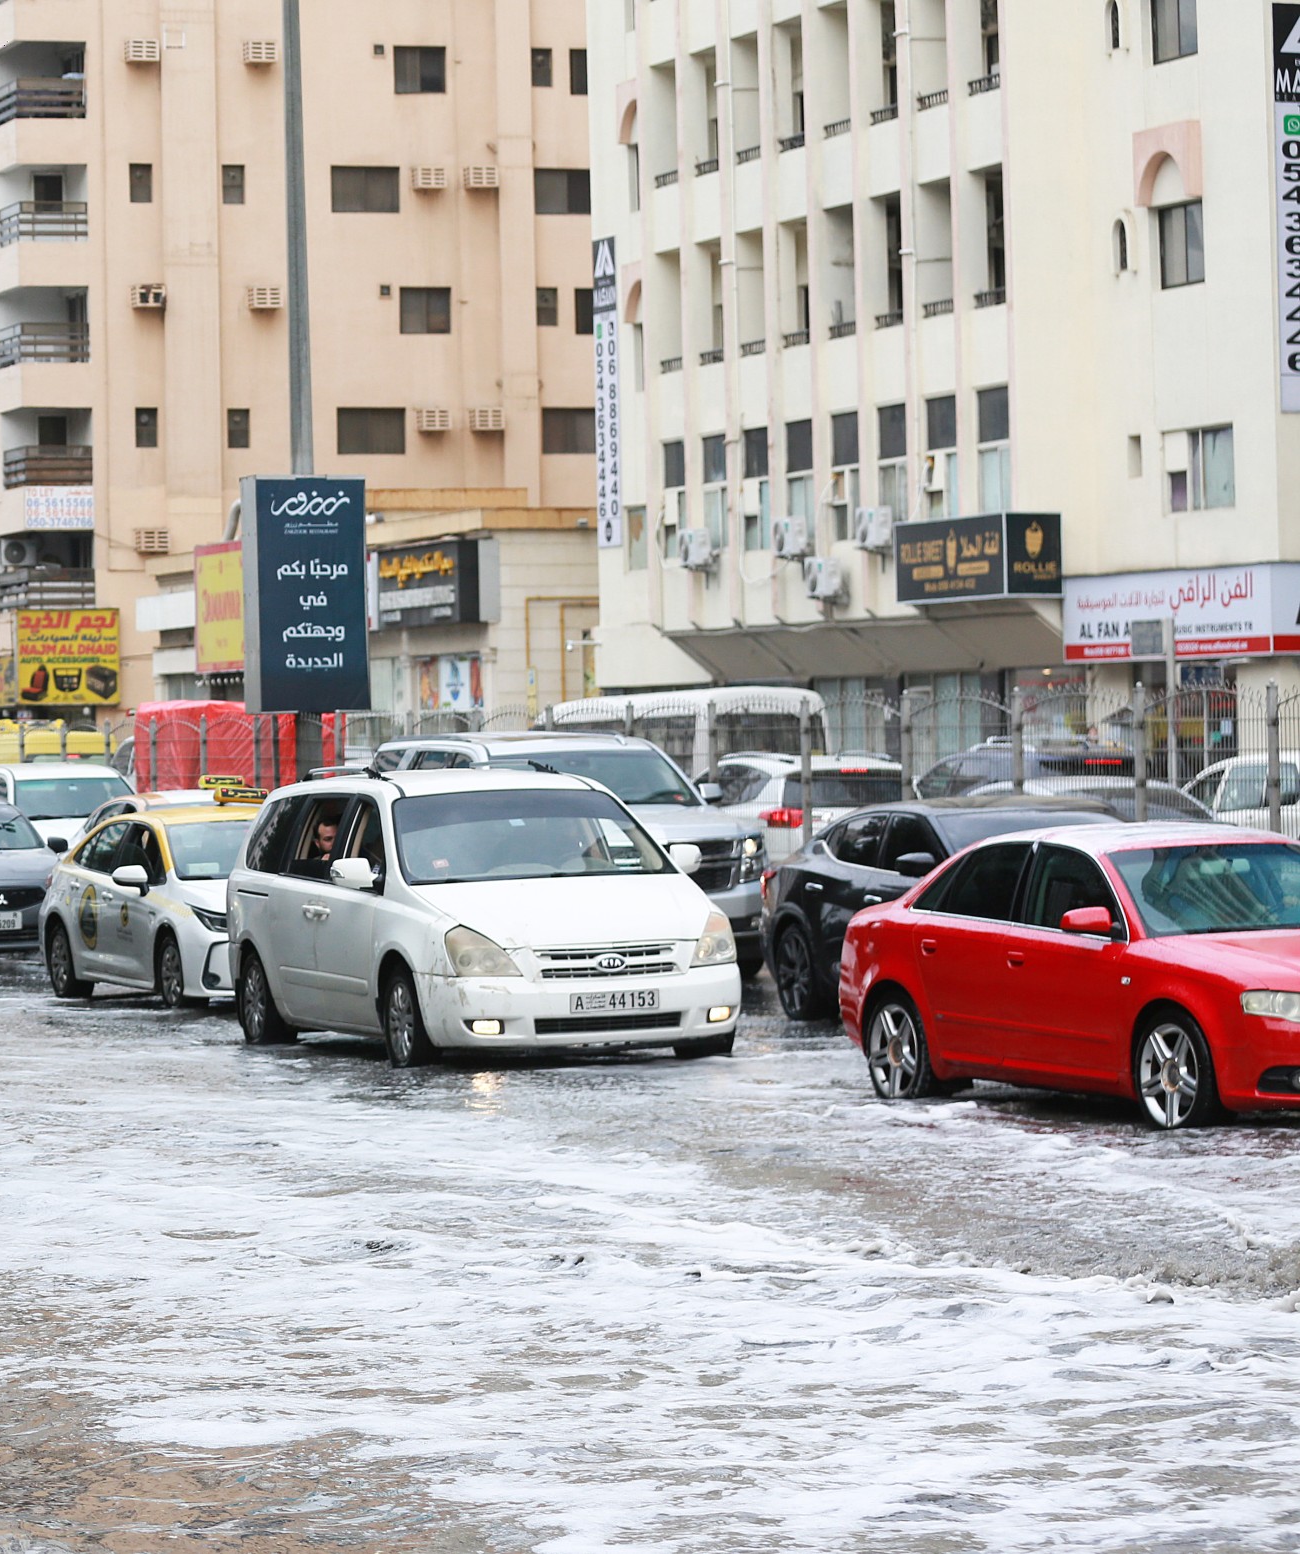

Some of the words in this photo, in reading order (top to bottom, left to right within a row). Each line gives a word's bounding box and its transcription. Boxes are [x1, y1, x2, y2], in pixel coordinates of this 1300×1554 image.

[277, 560, 306, 580] بكم
[1013, 560, 1057, 574] ROLLIE
[1220, 570, 1253, 608] الفن
[299, 591, 328, 611] في
[75, 611, 116, 633] نجم
[1079, 622, 1094, 639] AL
[1097, 621, 1120, 638] FAN
[1173, 624, 1193, 634] USIC
[282, 622, 346, 643] وجهتكم
[20, 643, 57, 655] NAJM
[59, 643, 74, 655] AL
[285, 652, 344, 672] الجديدة
[601, 958, 622, 968] KIA
[575, 995, 584, 1011] A
[608, 990, 656, 1010] 44153
